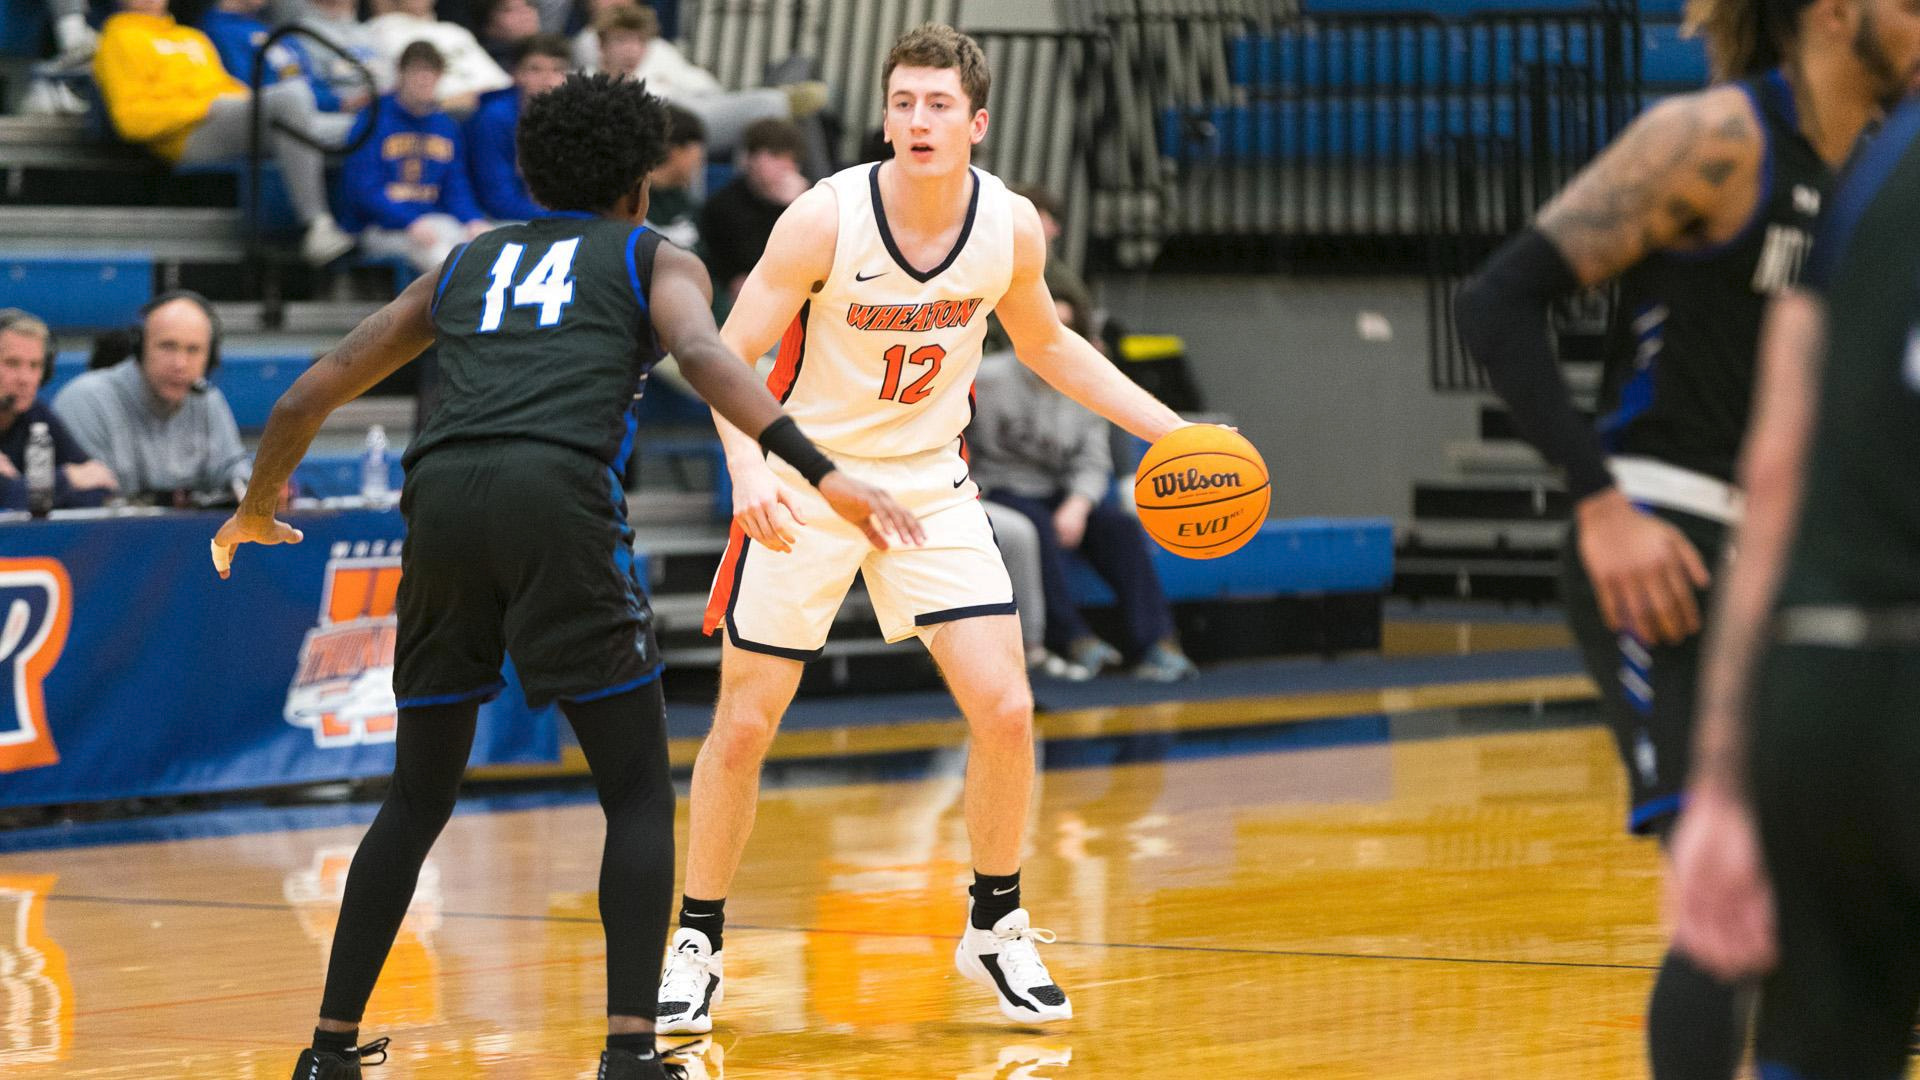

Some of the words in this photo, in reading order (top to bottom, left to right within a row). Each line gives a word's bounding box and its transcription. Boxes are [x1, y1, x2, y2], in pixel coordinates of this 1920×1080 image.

[476, 235, 583, 334] 14
[846, 298, 984, 332] WHEATON
[878, 344, 947, 405] 12
[1151, 468, 1243, 499] Wilson
